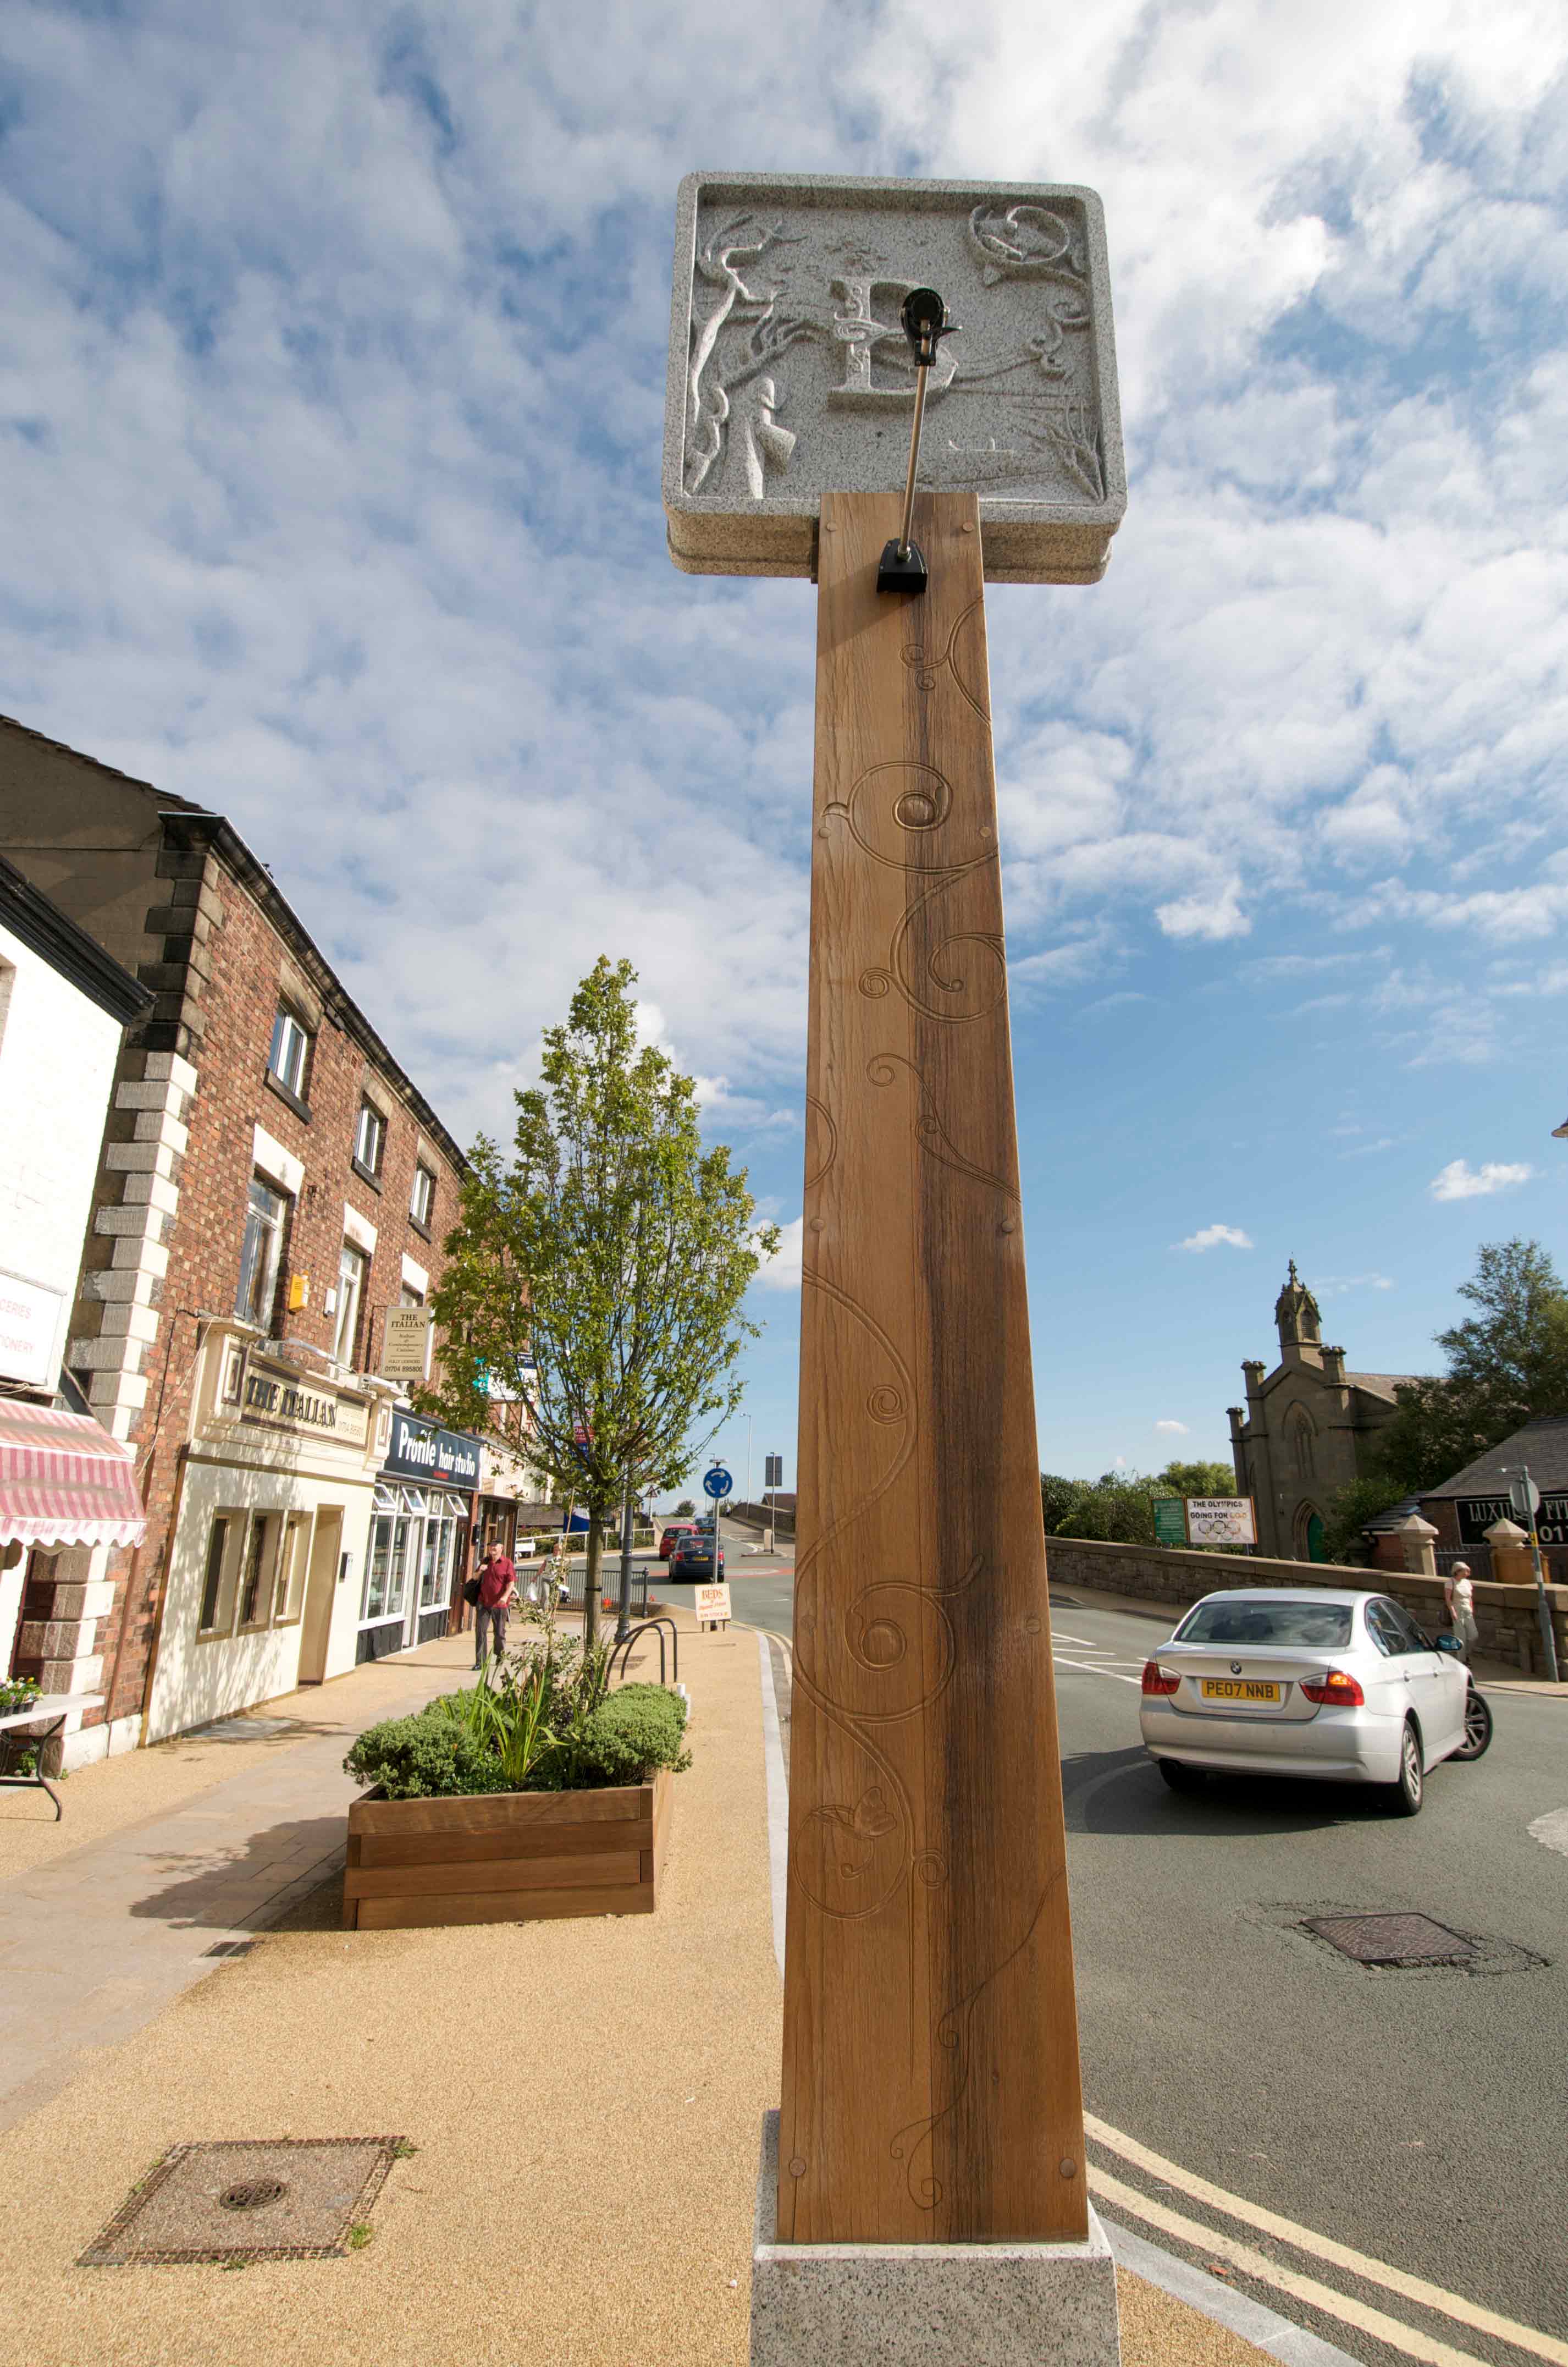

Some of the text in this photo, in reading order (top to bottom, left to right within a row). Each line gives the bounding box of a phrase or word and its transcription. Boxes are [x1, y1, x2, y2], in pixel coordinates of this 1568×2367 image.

[247, 1375, 339, 1430] THE ITALIAN
[398, 1422, 436, 1467] Profile
[439, 1443, 455, 1471] hair
[455, 1452, 476, 1477] studio
[1207, 1681, 1273, 1698] PE07 NNB
